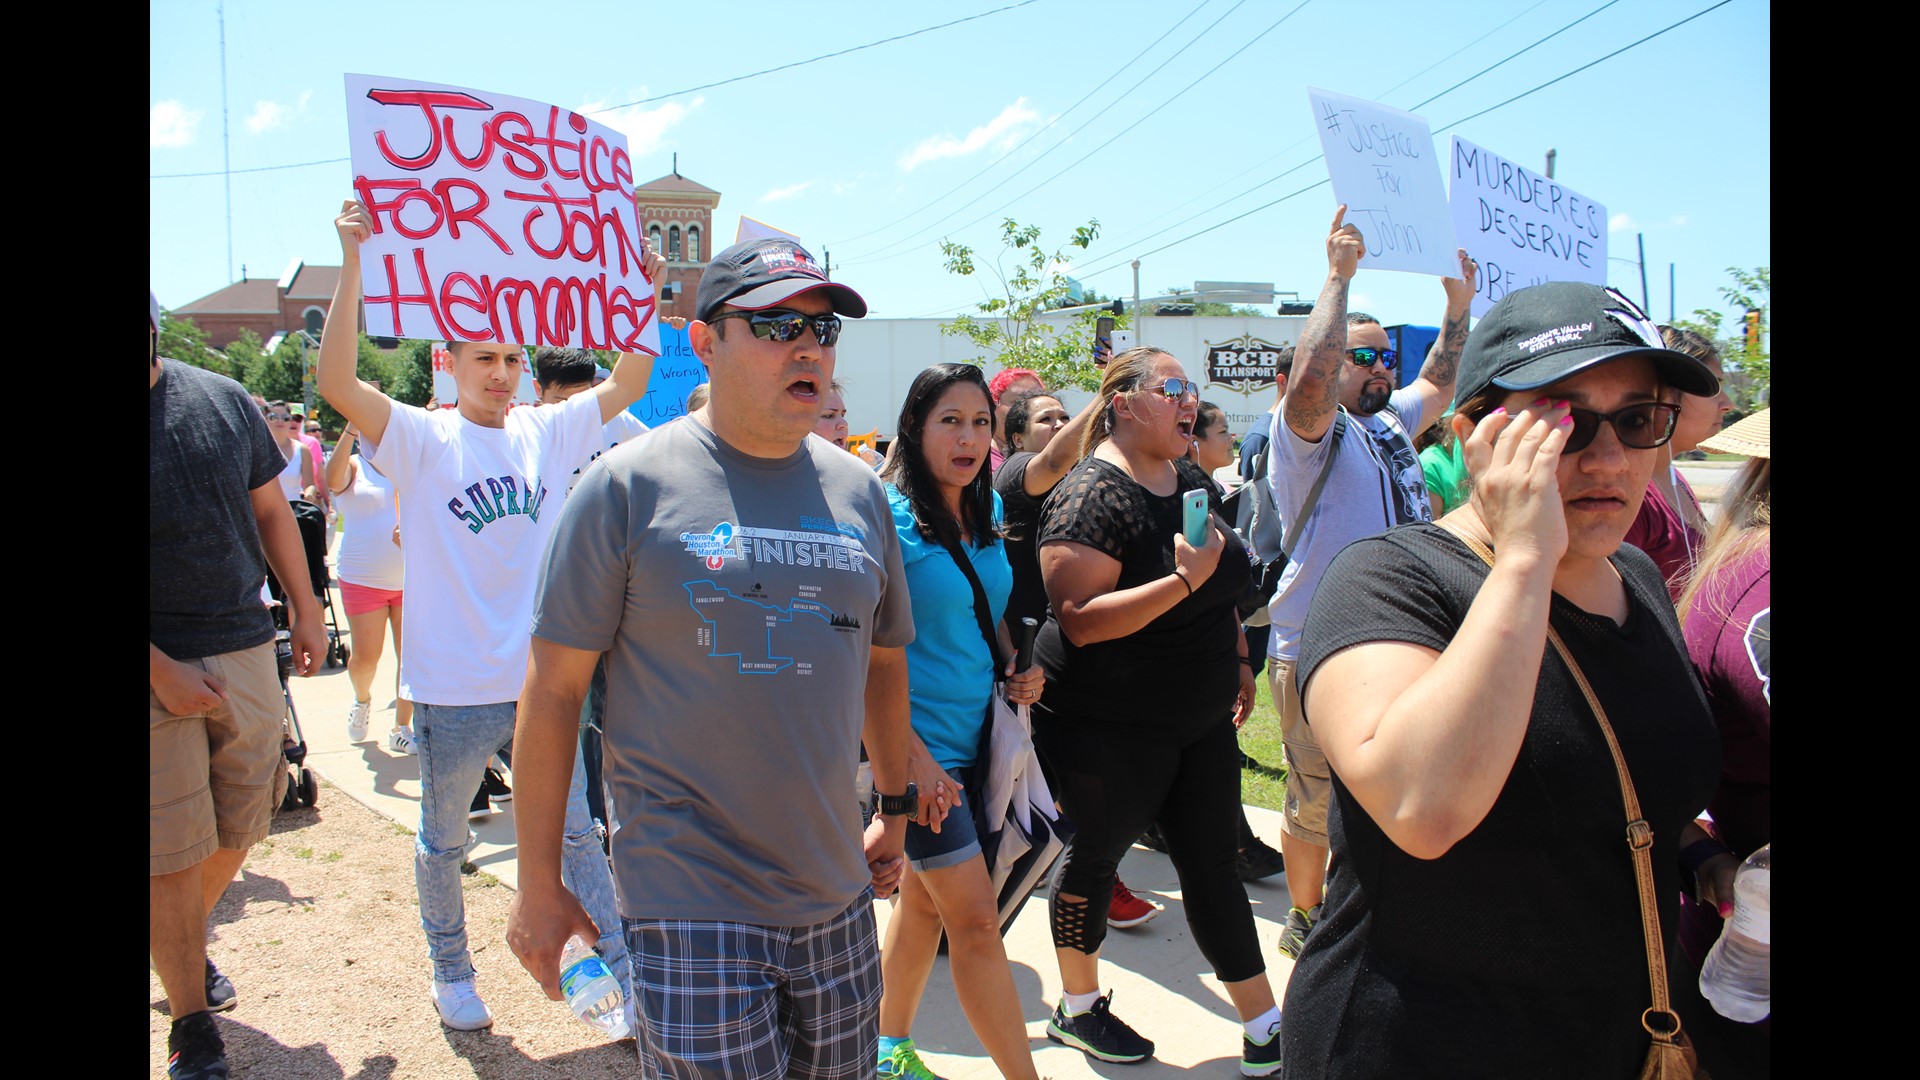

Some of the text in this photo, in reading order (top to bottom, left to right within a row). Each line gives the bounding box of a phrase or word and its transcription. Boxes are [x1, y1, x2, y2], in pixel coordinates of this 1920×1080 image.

[367, 88, 634, 203] Justice
[1456, 140, 1599, 239] MURDERES
[353, 176, 513, 256] FOR
[1350, 205, 1422, 258] John
[1478, 196, 1594, 269] DESERVE
[1560, 321, 1593, 336] VALLEY
[1529, 331, 1583, 354] STATE PARK
[1214, 351, 1277, 367] BCB
[1214, 367, 1277, 377] TRANSPORT
[640, 389, 685, 421] Just
[1224, 411, 1260, 423] btrans
[680, 532, 712, 541] Chevron
[688, 540, 721, 549] Houston
[783, 531, 825, 542] JANUARY
[697, 548, 736, 556] Marathon
[735, 536, 866, 574] FINISHER
